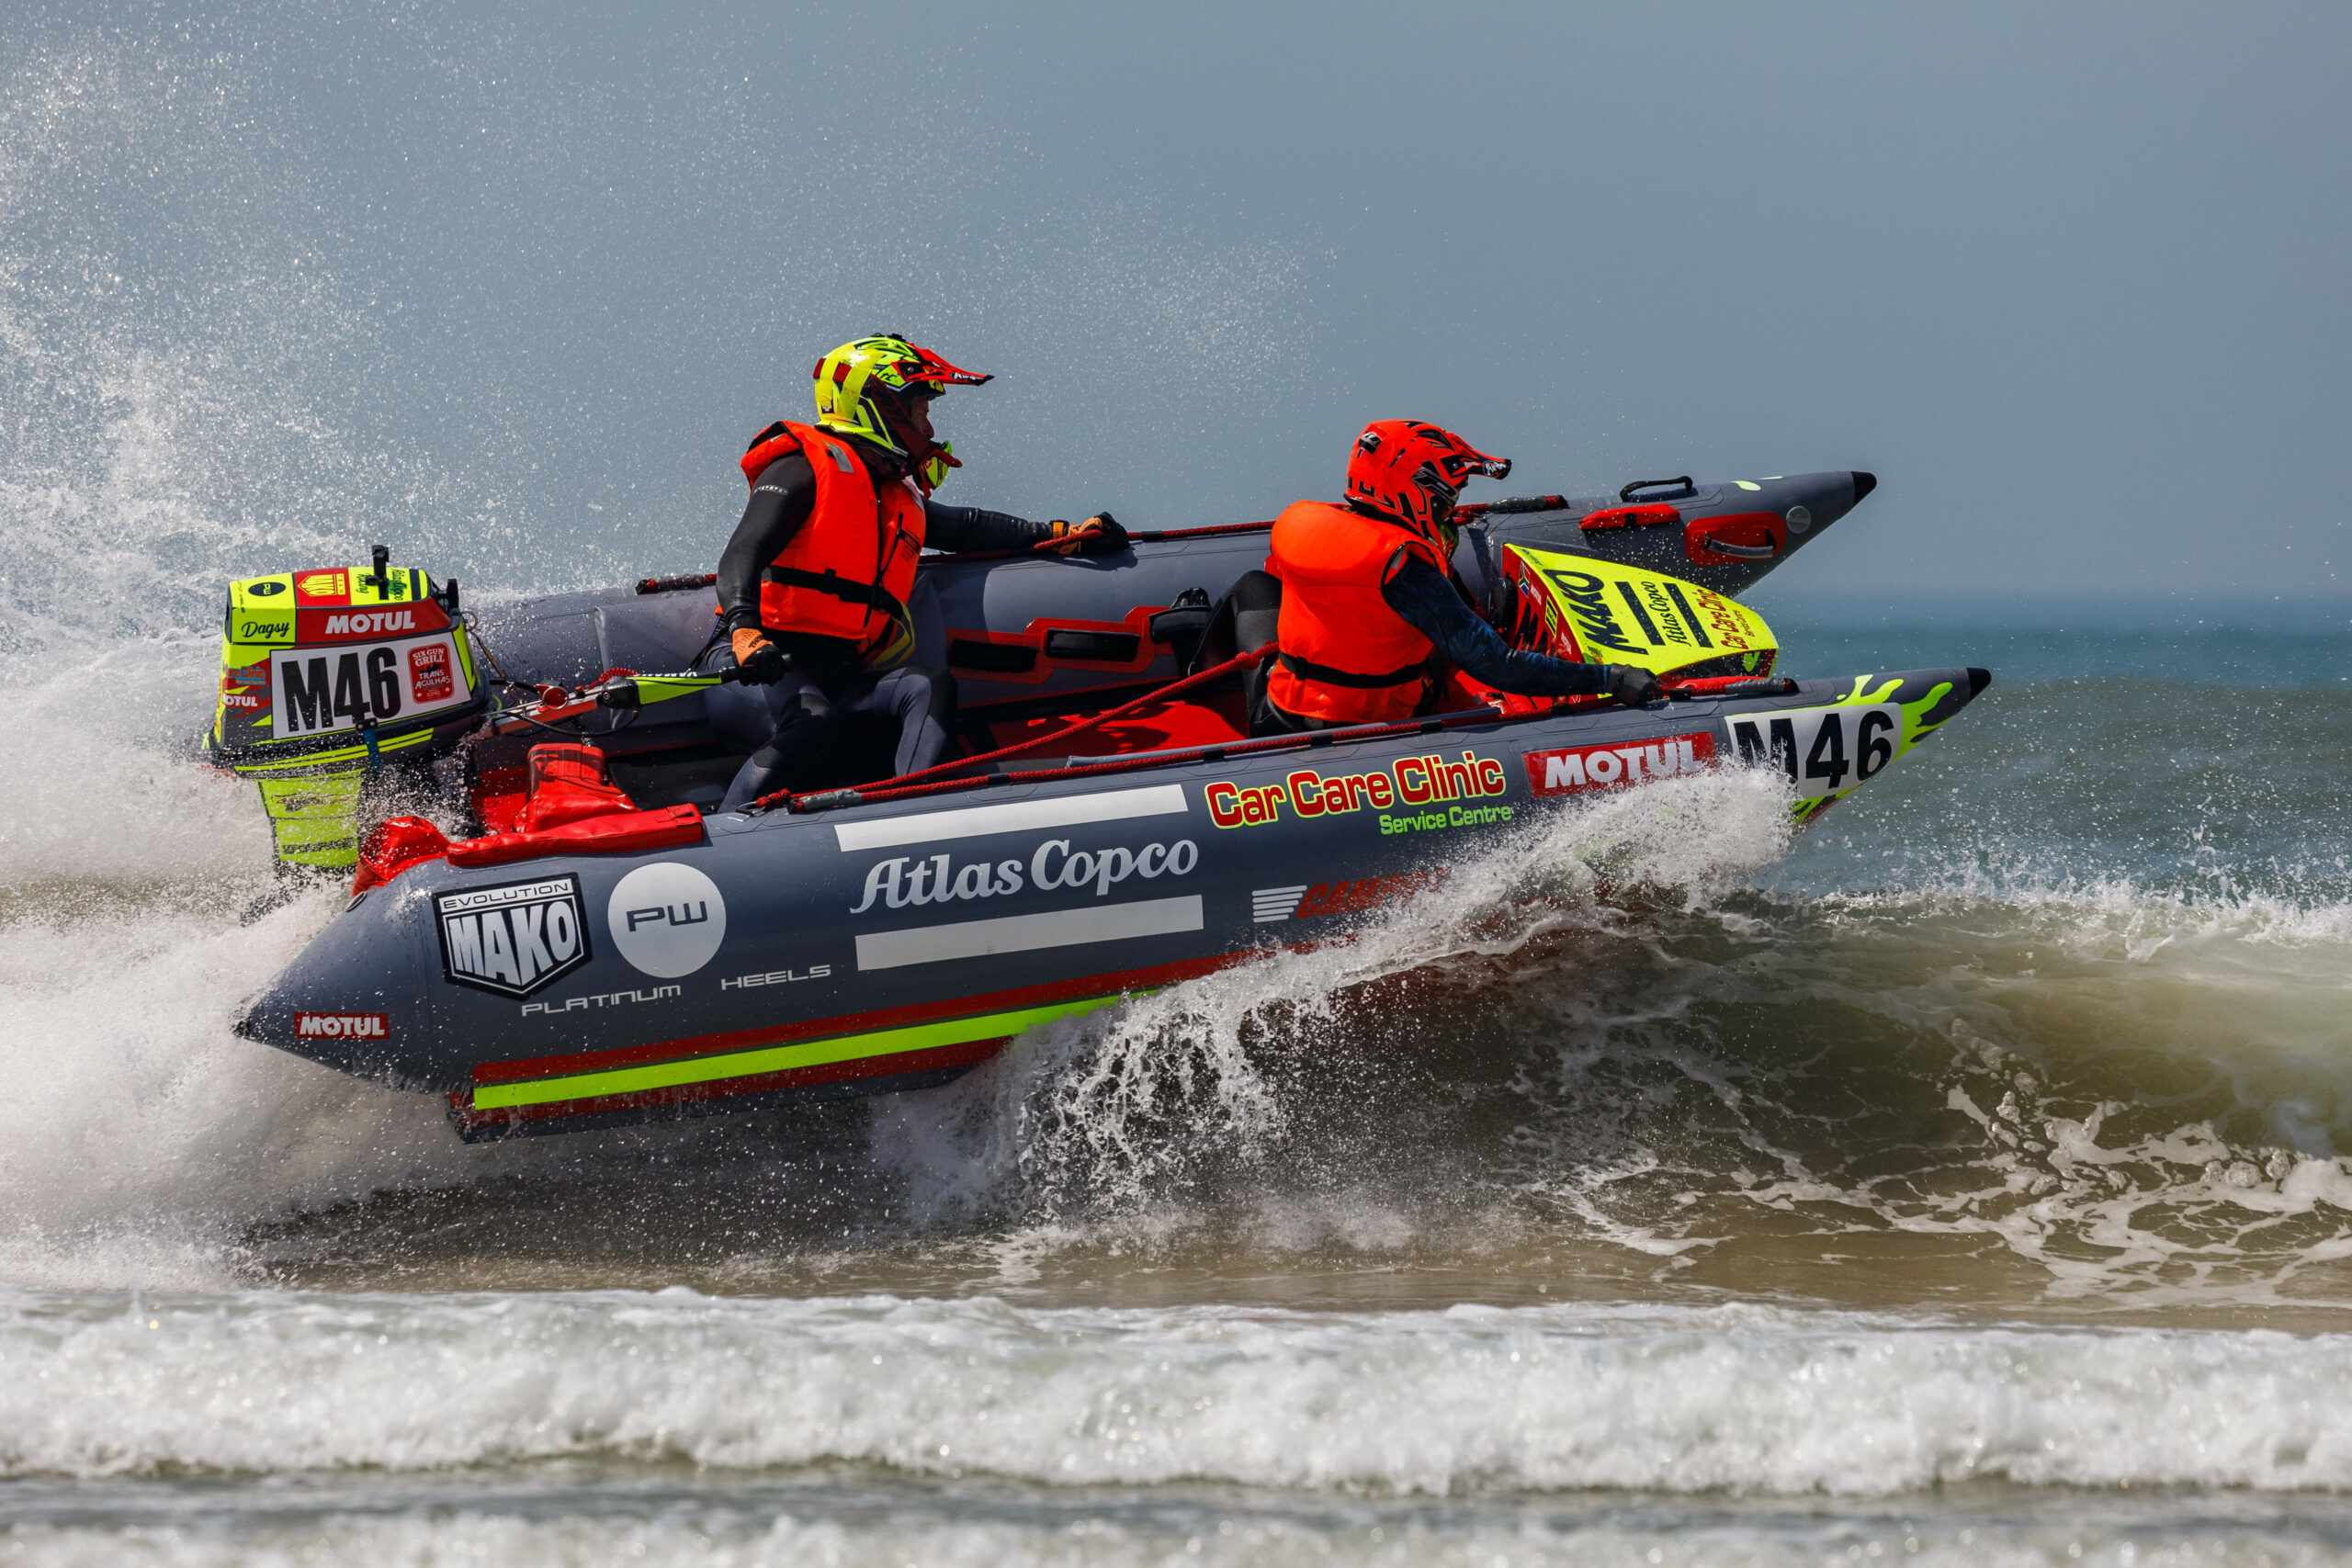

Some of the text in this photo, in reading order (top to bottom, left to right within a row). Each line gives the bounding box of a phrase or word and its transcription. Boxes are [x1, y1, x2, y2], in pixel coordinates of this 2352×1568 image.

[242, 621, 290, 638] Dagsy
[325, 610, 416, 635] MOTUL
[1641, 581, 1691, 647] Atlas Copco
[414, 654, 446, 667] GRILL
[418, 669, 445, 680] TRANS
[281, 647, 401, 732] M46
[414, 675, 451, 690] AGULHAS
[1544, 739, 1704, 789] MOTUL
[1734, 710, 1895, 790] M46
[1204, 750, 1507, 829] Car Care Clinic
[1379, 805, 1512, 835] Service Centre
[850, 840, 1199, 914] Atlas Copco
[443, 881, 570, 910] EVOLUTION
[626, 900, 708, 933] PW
[448, 900, 577, 987] MAKO
[521, 964, 831, 1018] PLATINUM HEELS
[299, 1015, 386, 1038] MOTUL
